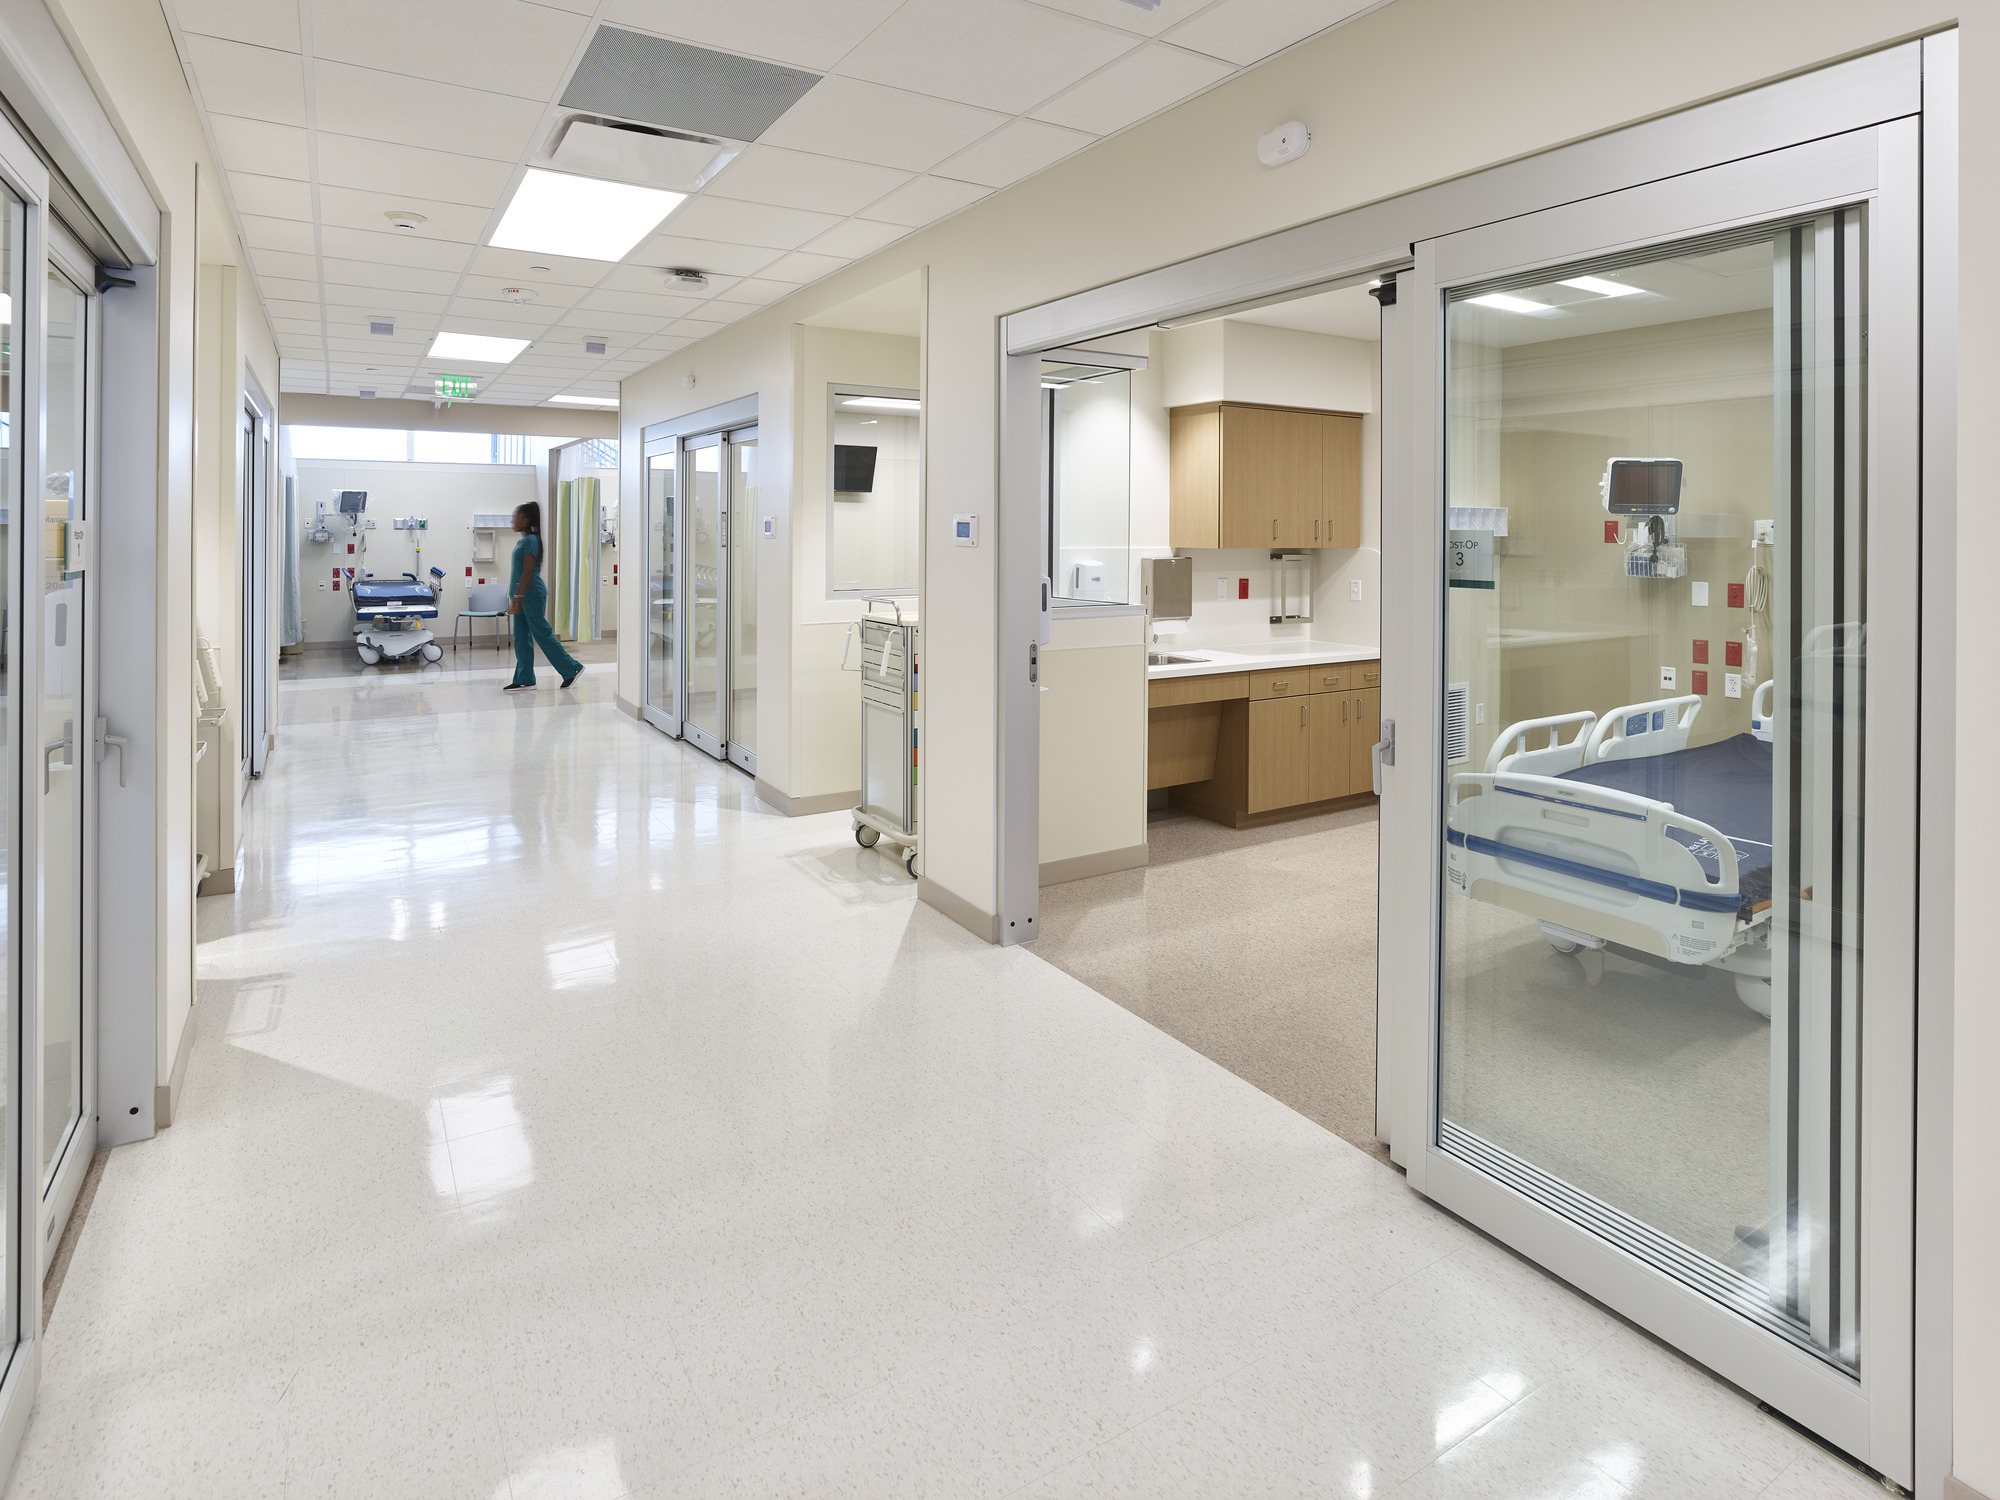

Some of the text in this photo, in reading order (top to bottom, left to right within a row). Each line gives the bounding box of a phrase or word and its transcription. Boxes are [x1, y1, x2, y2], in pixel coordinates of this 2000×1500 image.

[442, 375, 471, 397] EXIT
[1449, 540, 1479, 549] OST-OP
[1456, 551, 1464, 566] 3
